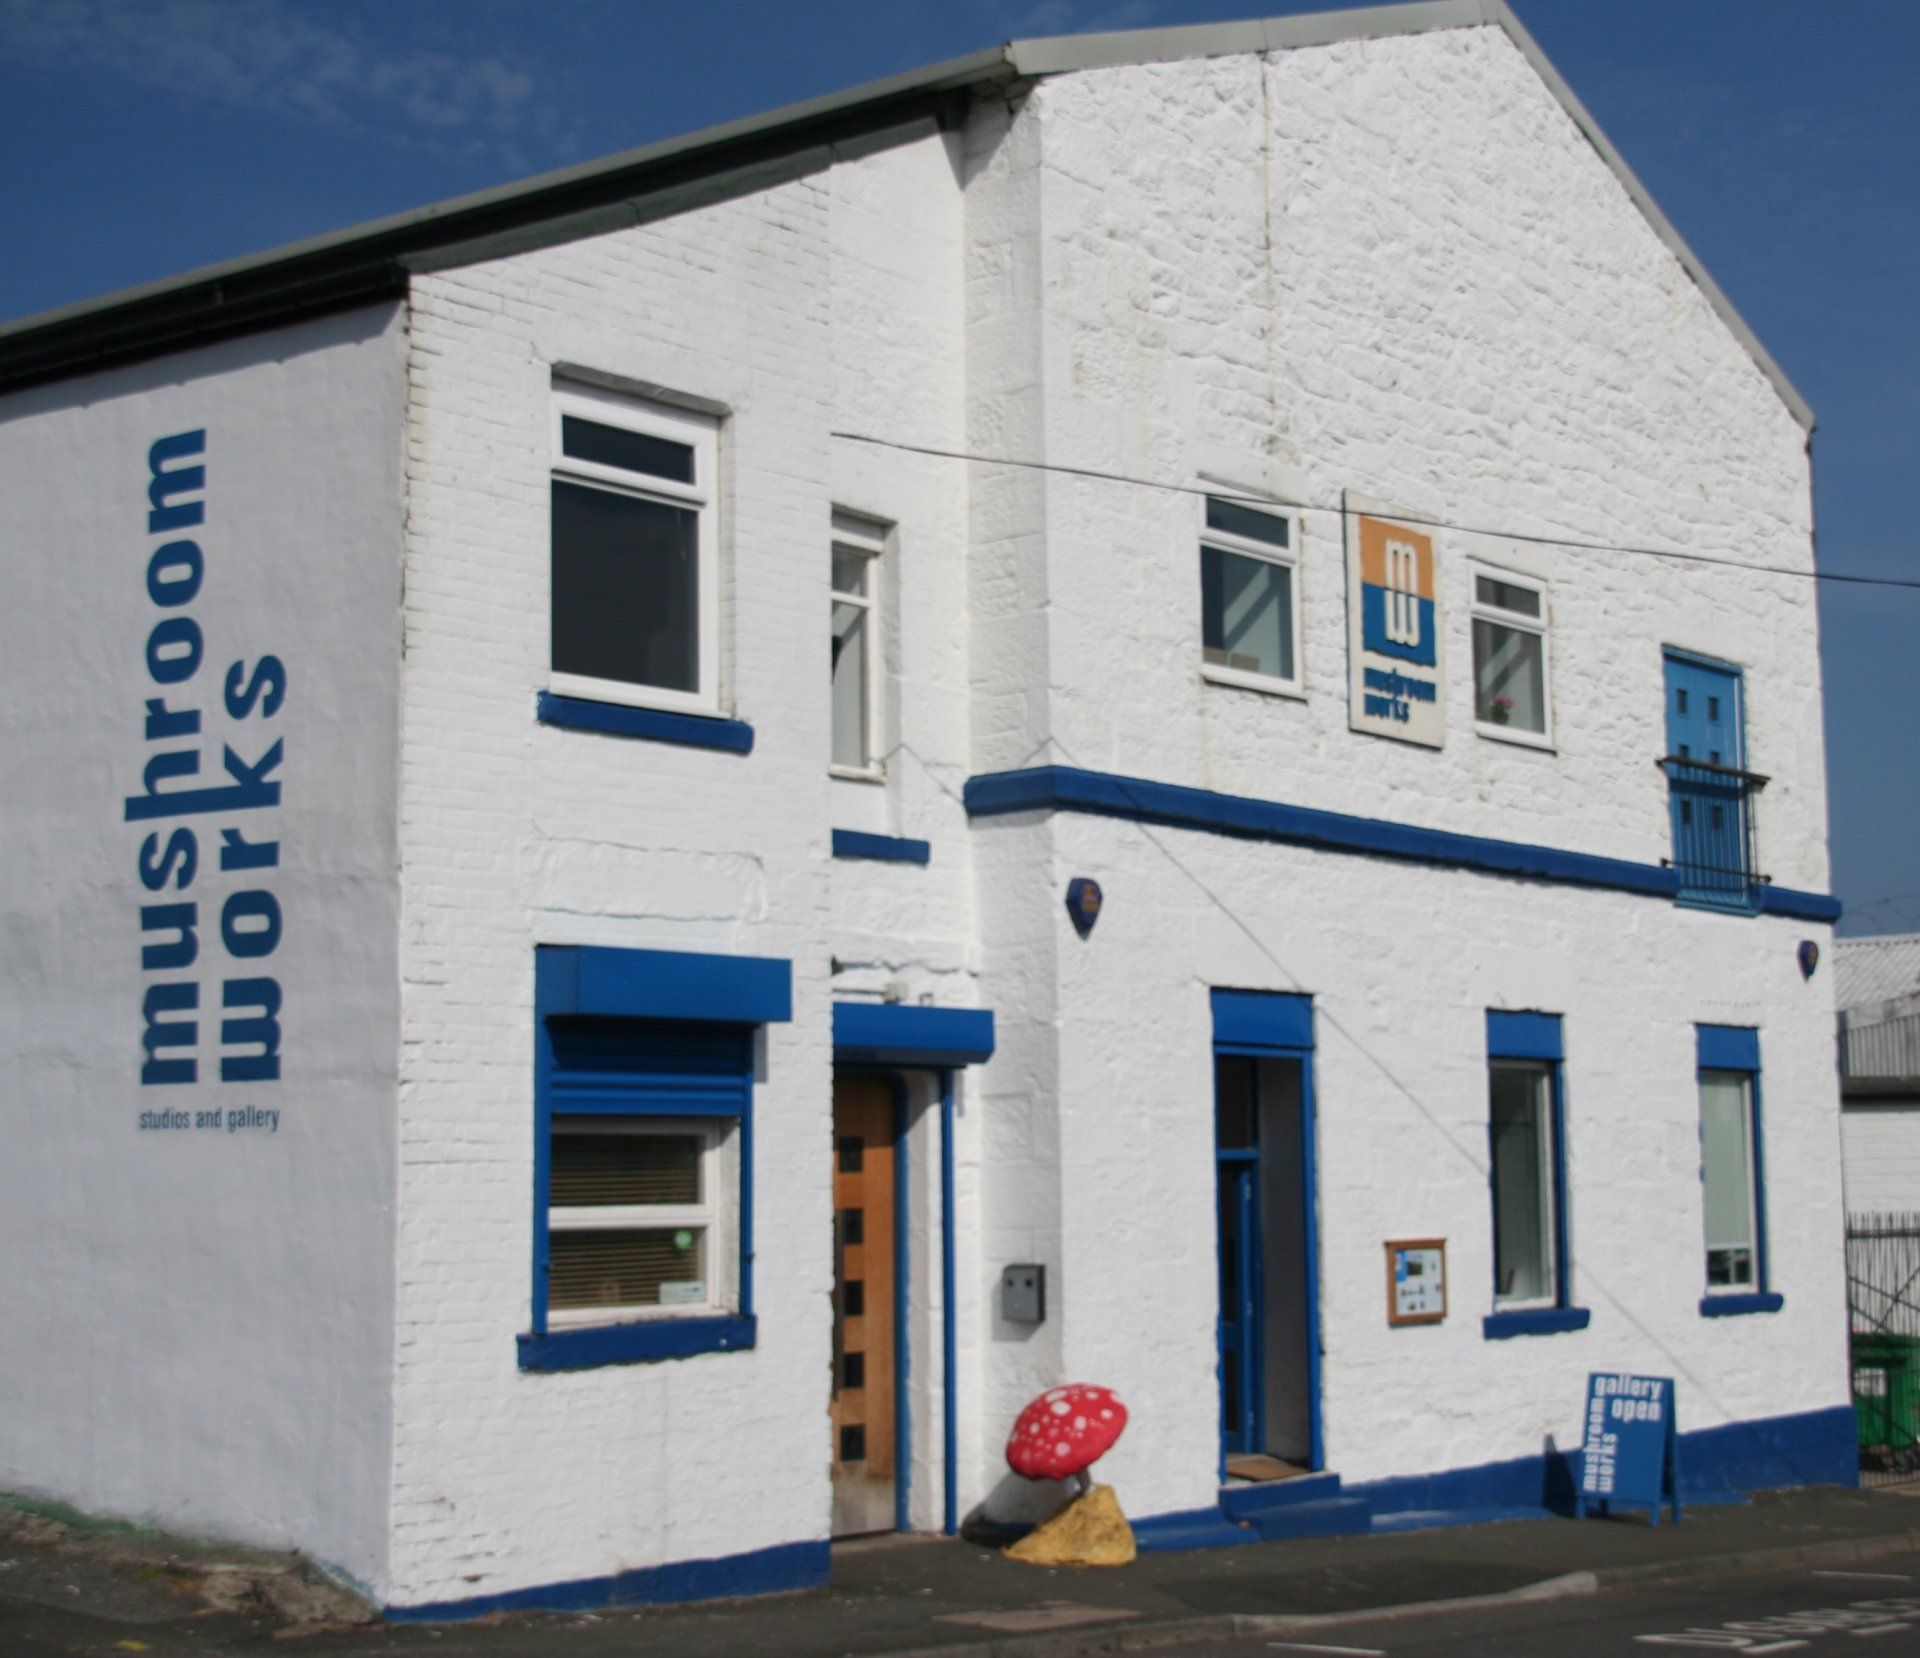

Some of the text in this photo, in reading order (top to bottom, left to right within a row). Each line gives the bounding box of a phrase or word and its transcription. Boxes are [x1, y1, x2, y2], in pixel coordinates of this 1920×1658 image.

[124, 428, 207, 1085] mushroom
[217, 654, 287, 1083] works
[139, 1105, 280, 1133] studios and gallery
[1595, 1374, 1664, 1400] gallery
[1611, 1399, 1662, 1423] open
